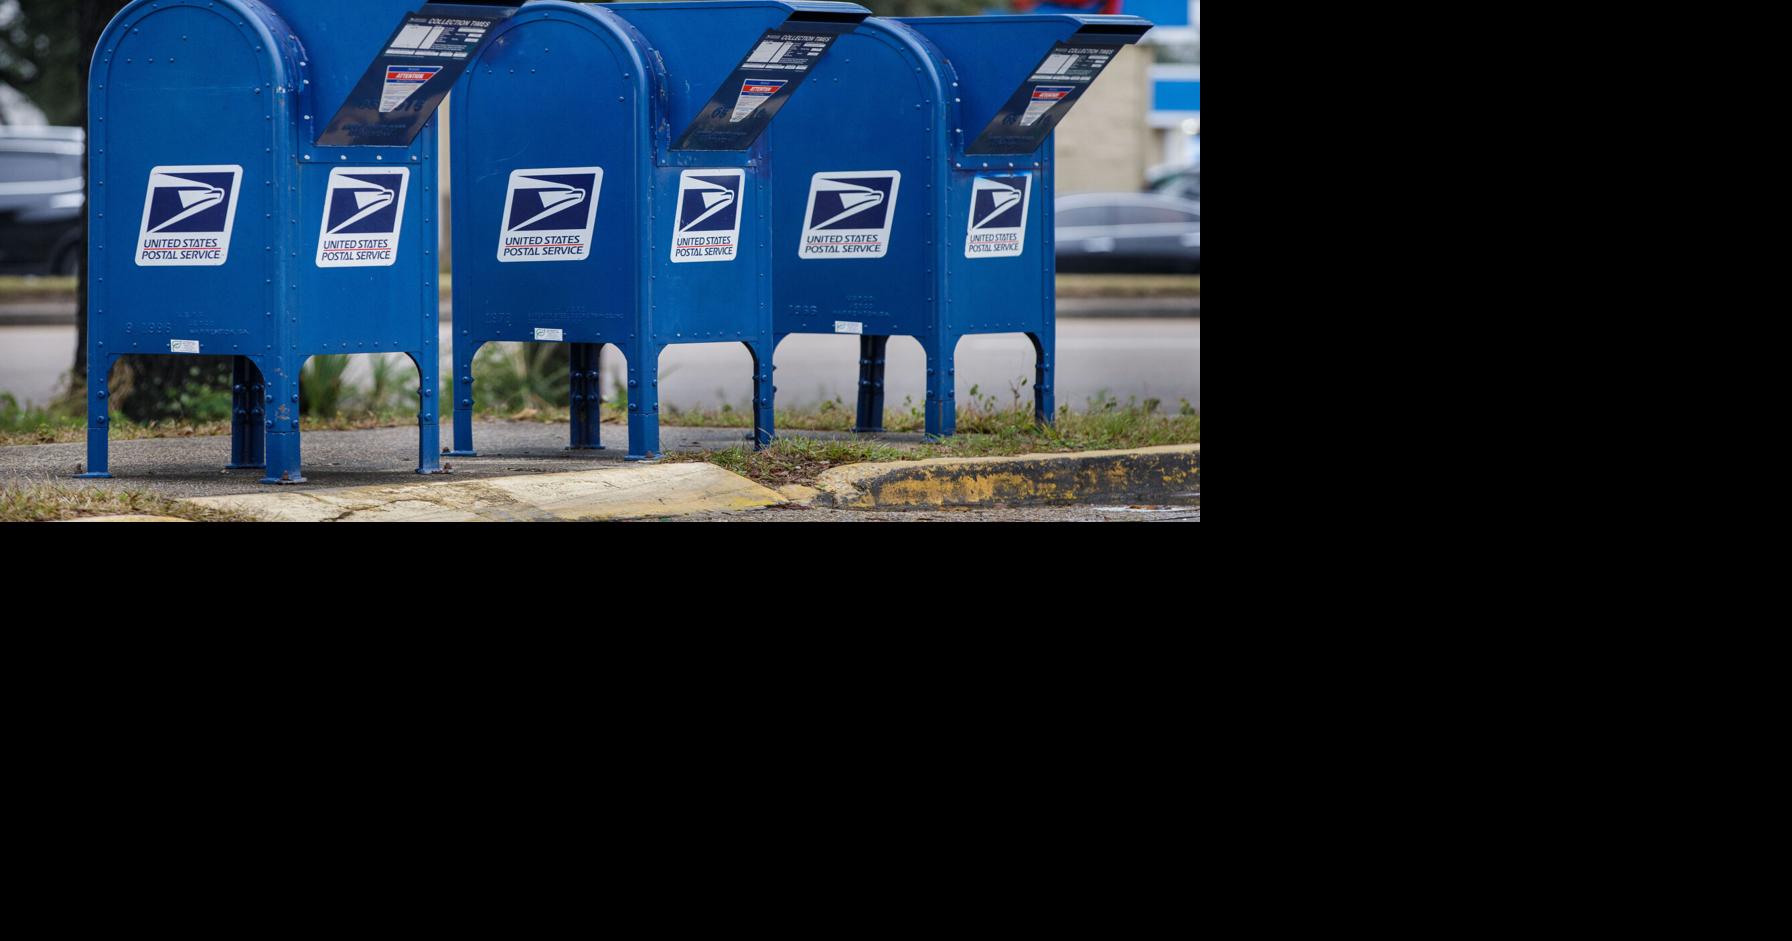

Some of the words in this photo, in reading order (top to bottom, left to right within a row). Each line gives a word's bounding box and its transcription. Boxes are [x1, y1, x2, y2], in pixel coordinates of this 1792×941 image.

[428, 18, 469, 26] COLLECTION
[470, 19, 491, 27] TIMES
[505, 236, 543, 245] UNITED
[543, 235, 580, 244] STATES
[676, 237, 705, 246] UNITED
[705, 236, 731, 245] STATES
[807, 235, 843, 243] UNITED
[844, 234, 879, 242] STATES
[995, 233, 1017, 241] STATES
[144, 239, 181, 248] UNITED
[182, 238, 218, 247] STATES
[323, 240, 357, 249] UNITED
[357, 239, 388, 248] STATES
[968, 244, 993, 253] POSTAL
[993, 243, 1019, 251] SERVICE
[503, 247, 540, 256] POSTAL
[542, 246, 584, 255] SERVICE
[675, 248, 703, 257] POSTAL
[704, 246, 733, 256] SERVICE
[804, 245, 840, 253] POSTAL
[842, 244, 881, 253] SERVICE
[141, 250, 178, 260] POSTAL
[180, 250, 221, 259] SERVICE
[321, 252, 354, 261] POSTAL
[355, 250, 391, 260] SERVICE
